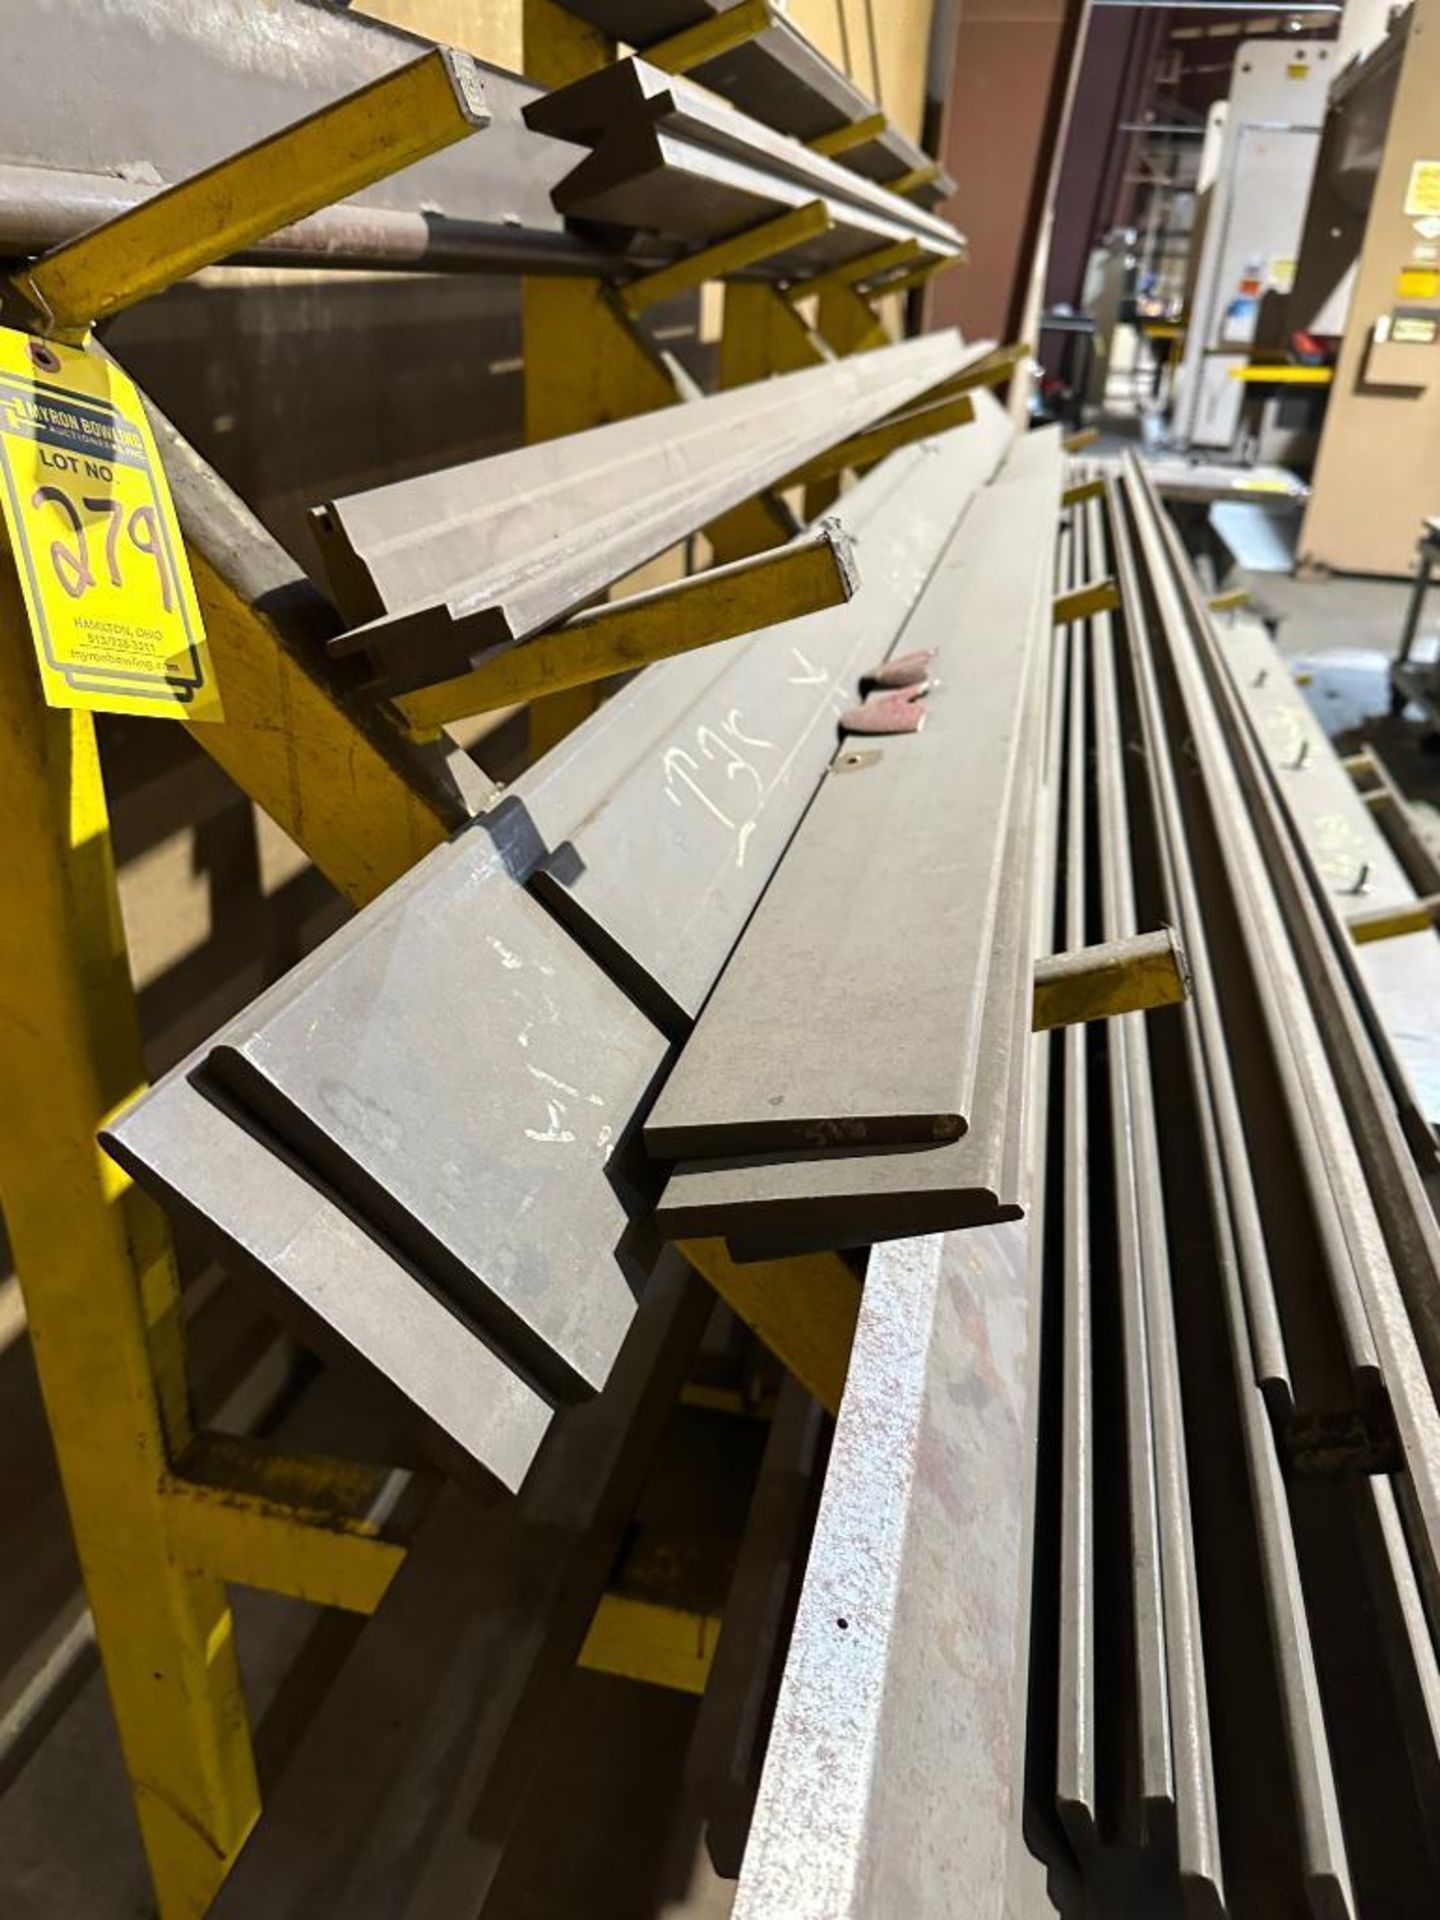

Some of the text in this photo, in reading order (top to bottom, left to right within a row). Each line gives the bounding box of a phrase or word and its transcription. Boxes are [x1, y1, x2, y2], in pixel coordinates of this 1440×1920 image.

[26, 401, 145, 449] MYRON BOWLING
[40, 448, 78, 473] LOT
[31, 485, 173, 614] 279
[136, 626, 164, 641] OHIO
